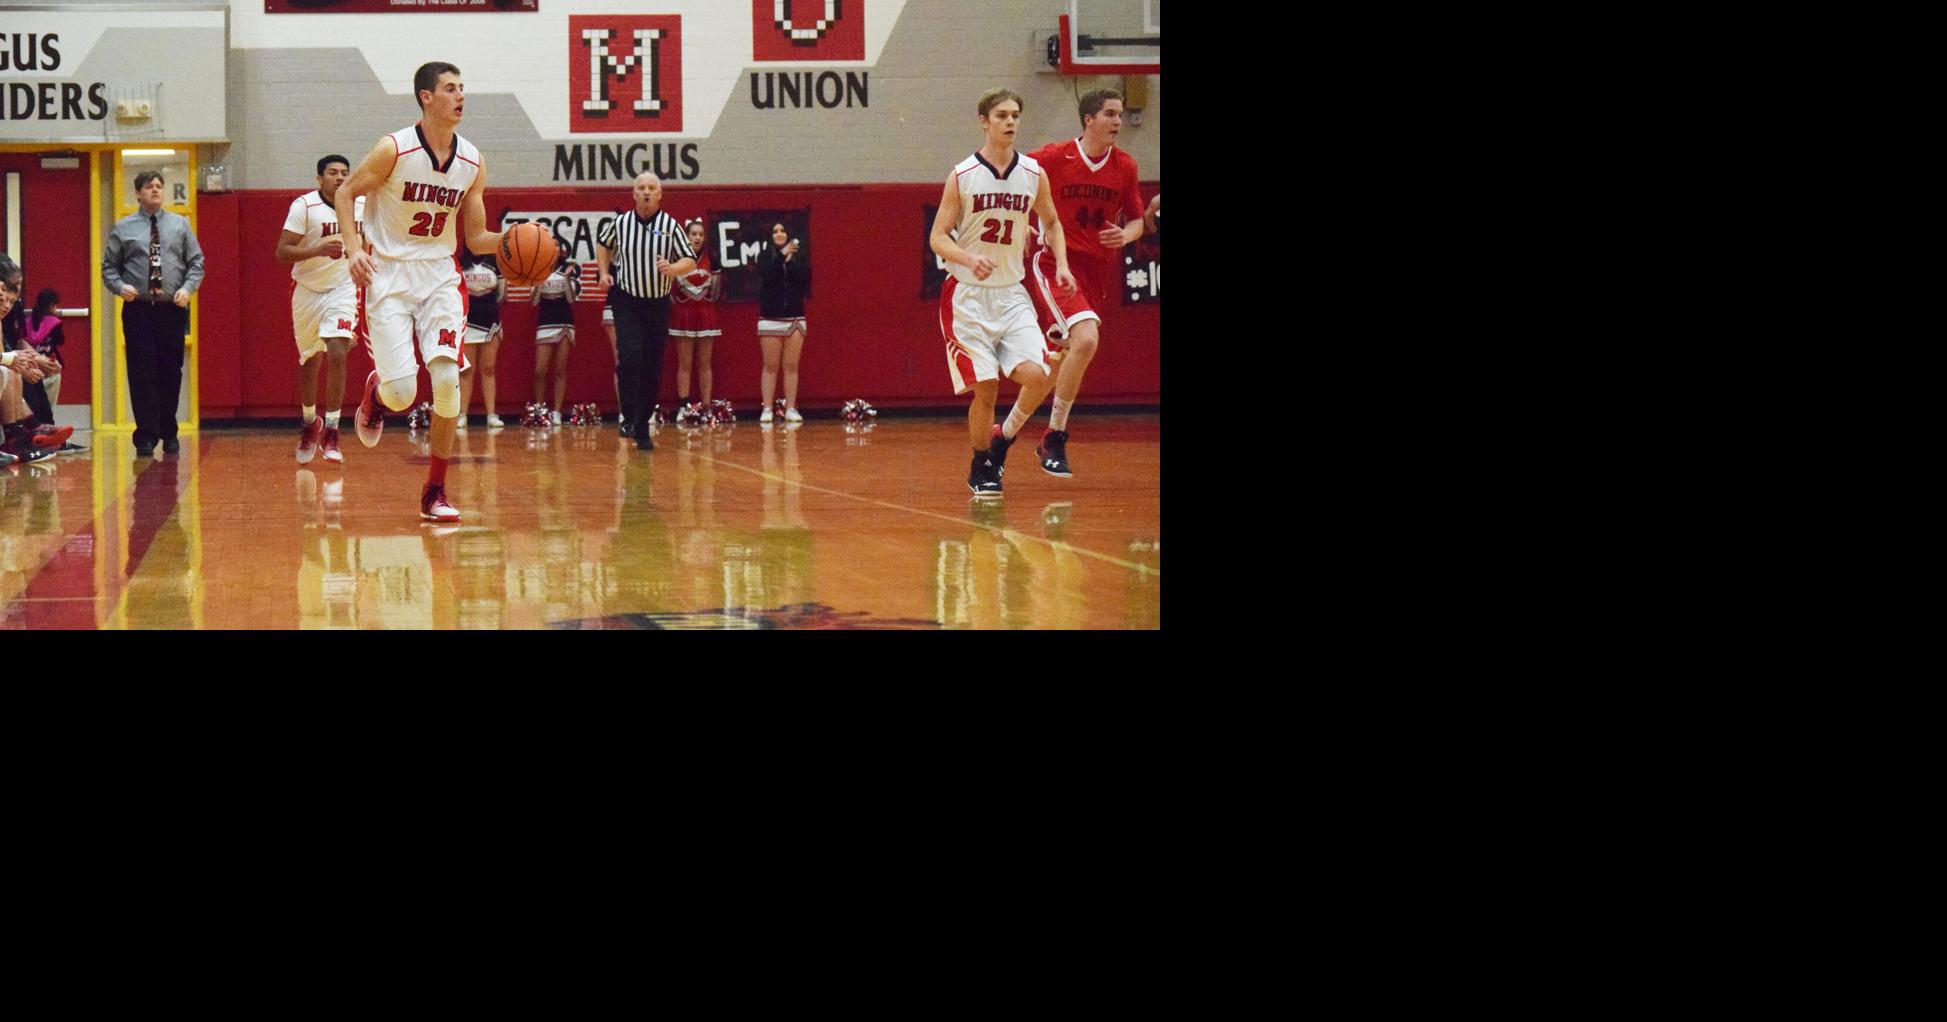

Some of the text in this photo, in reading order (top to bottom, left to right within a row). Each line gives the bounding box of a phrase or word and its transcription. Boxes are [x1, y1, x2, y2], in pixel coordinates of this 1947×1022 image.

[582, 29, 668, 118] M
[0, 82, 108, 120] DERS
[750, 71, 868, 109] UNION
[553, 143, 700, 181] MINGUS
[972, 192, 1030, 213] MINGUS
[408, 212, 449, 237] 25
[980, 218, 1014, 245] 21
[1126, 261, 1160, 297] #1
[337, 318, 352, 331] M
[438, 328, 456, 349] M
